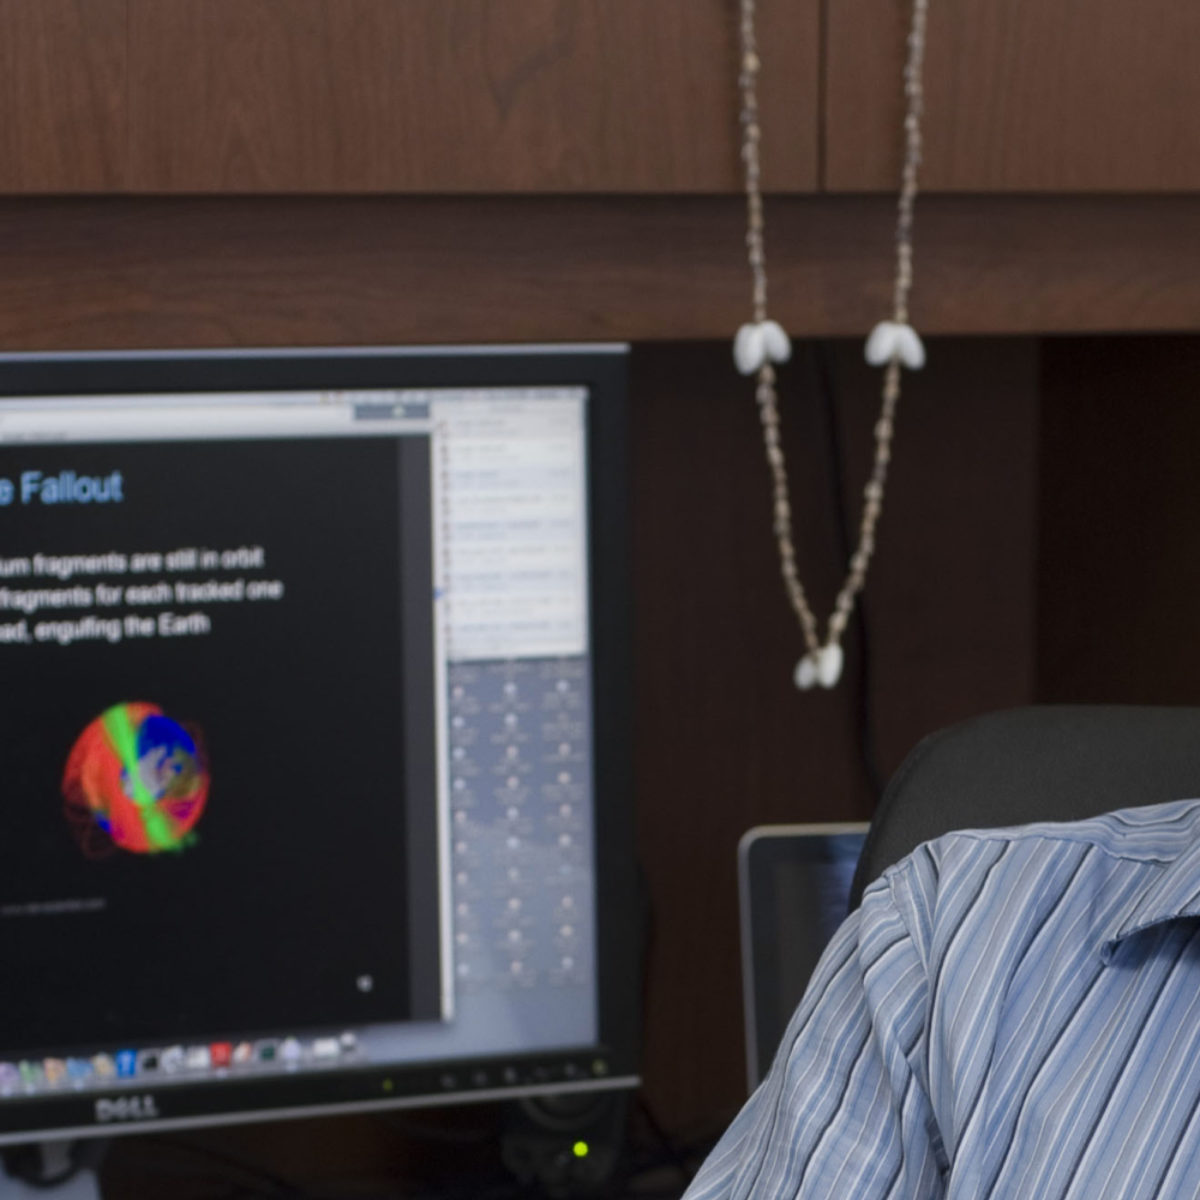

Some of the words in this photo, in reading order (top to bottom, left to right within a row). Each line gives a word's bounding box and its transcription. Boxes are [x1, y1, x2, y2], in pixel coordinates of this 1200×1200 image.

[21, 470, 124, 503] Fallout
[0, 557, 30, 577] um
[33, 552, 128, 579] fragments
[130, 552, 162, 573] are
[165, 548, 196, 571] still
[200, 547, 219, 569] in
[220, 546, 265, 569] orbit
[0, 586, 93, 613] fragments
[95, 583, 123, 605] for
[125, 581, 173, 605] each
[174, 579, 245, 603] tracked
[246, 580, 284, 600] one
[34, 616, 122, 645] engulfing
[124, 615, 156, 636] the
[158, 611, 212, 637] Earth
[95, 1095, 159, 1120] DELL
